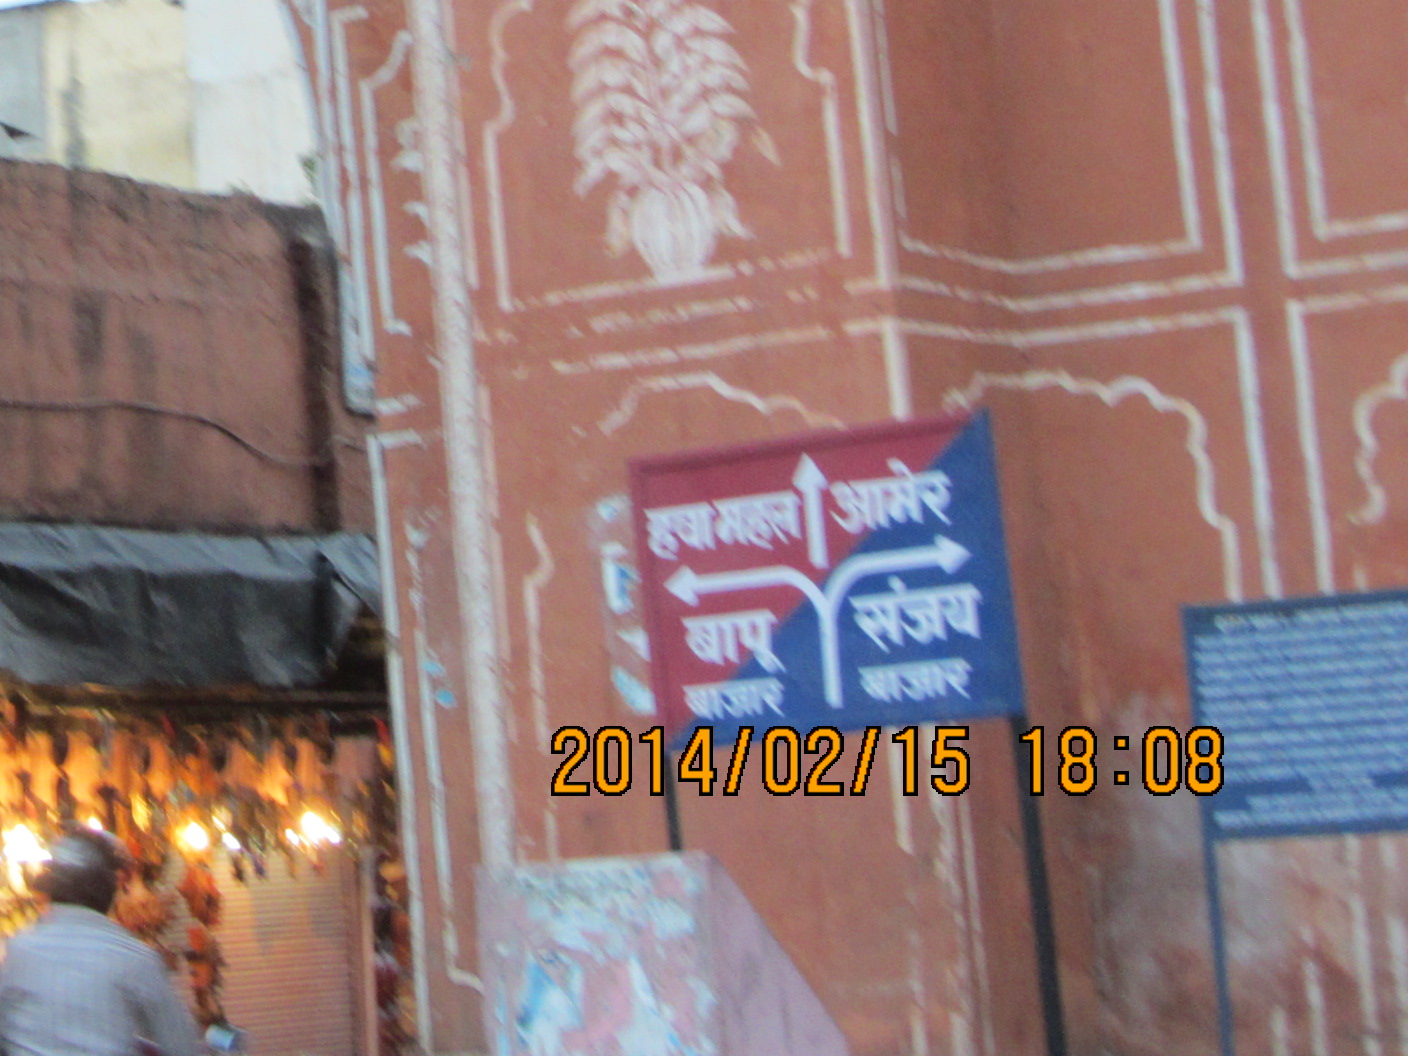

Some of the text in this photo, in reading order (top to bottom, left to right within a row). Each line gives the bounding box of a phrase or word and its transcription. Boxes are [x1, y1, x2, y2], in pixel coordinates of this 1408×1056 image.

[829, 457, 953, 535] आमेर
[680, 609, 787, 674] बापू
[848, 574, 983, 654] संजय
[682, 677, 786, 721] बाजार
[856, 657, 973, 704] बाजार
